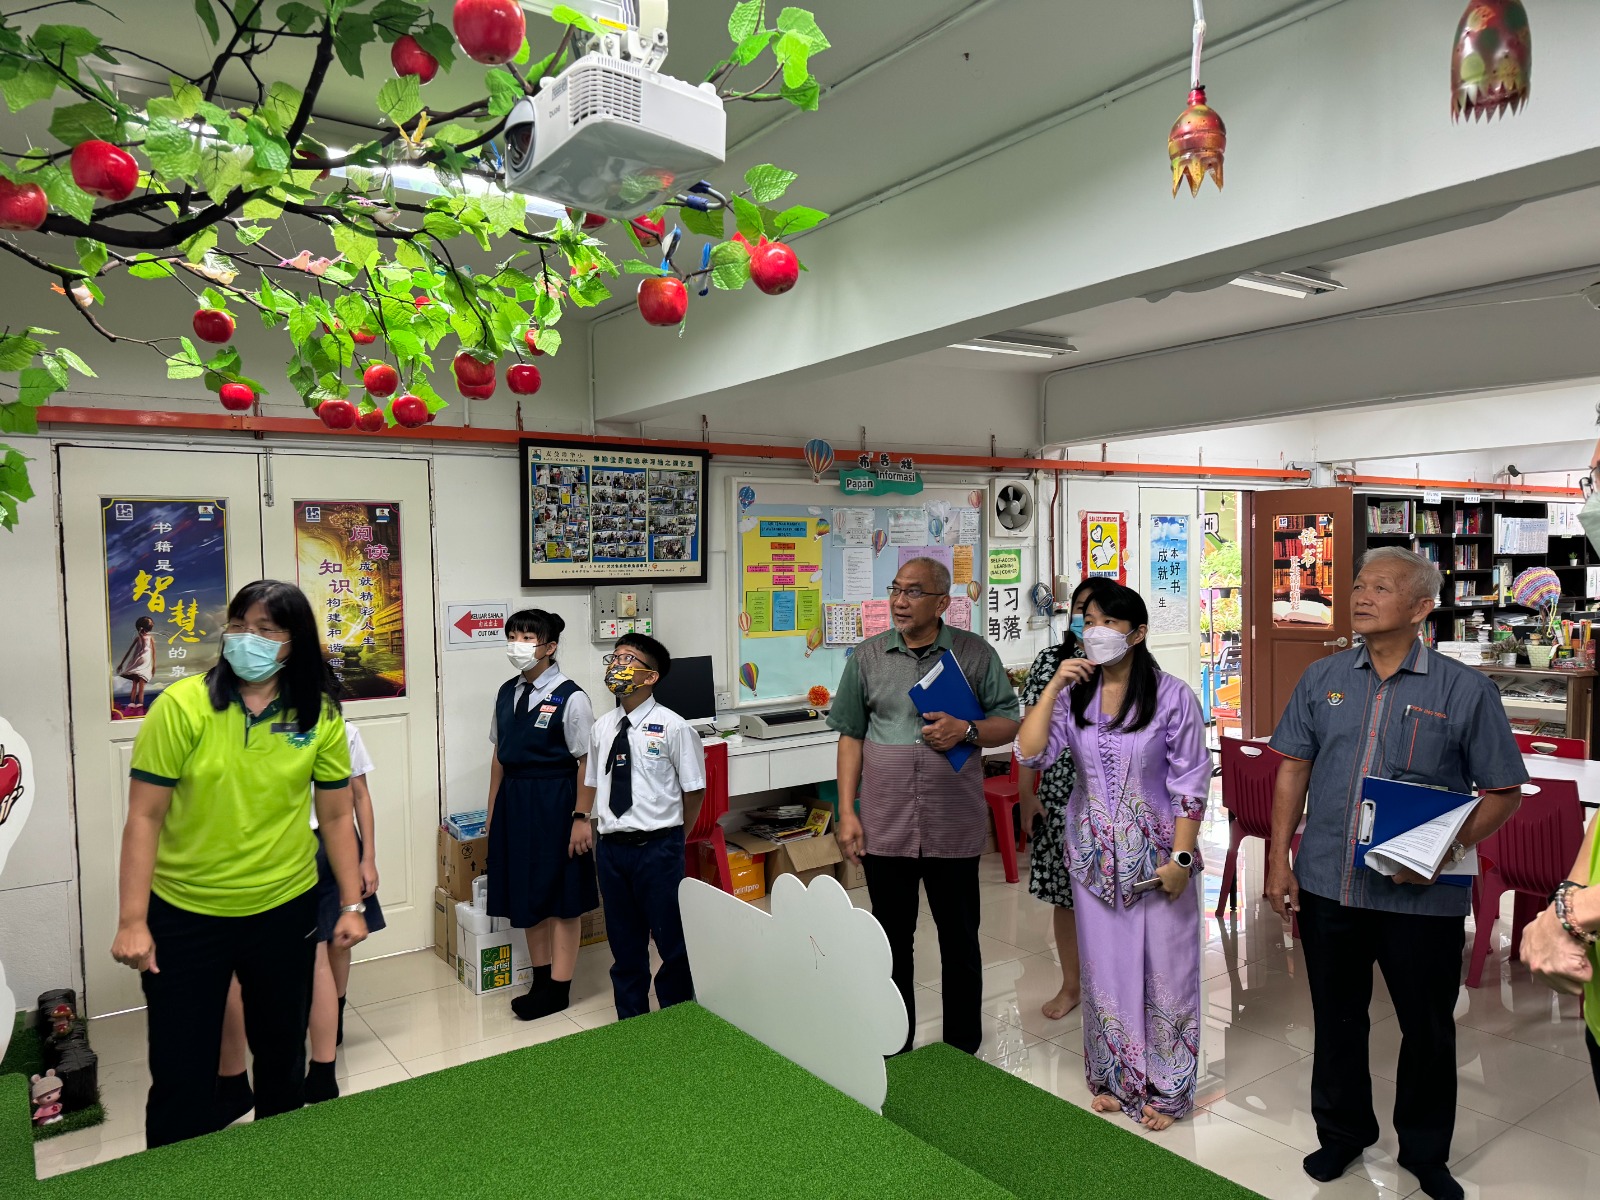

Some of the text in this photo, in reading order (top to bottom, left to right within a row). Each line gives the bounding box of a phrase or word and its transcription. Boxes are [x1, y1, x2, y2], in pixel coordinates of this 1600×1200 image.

[846, 470, 915, 490] Papan Informasi
[1205, 517, 1213, 530] Hi
[1157, 548, 1168, 608] 成就一生
[1170, 538, 1181, 593] 一本好书
